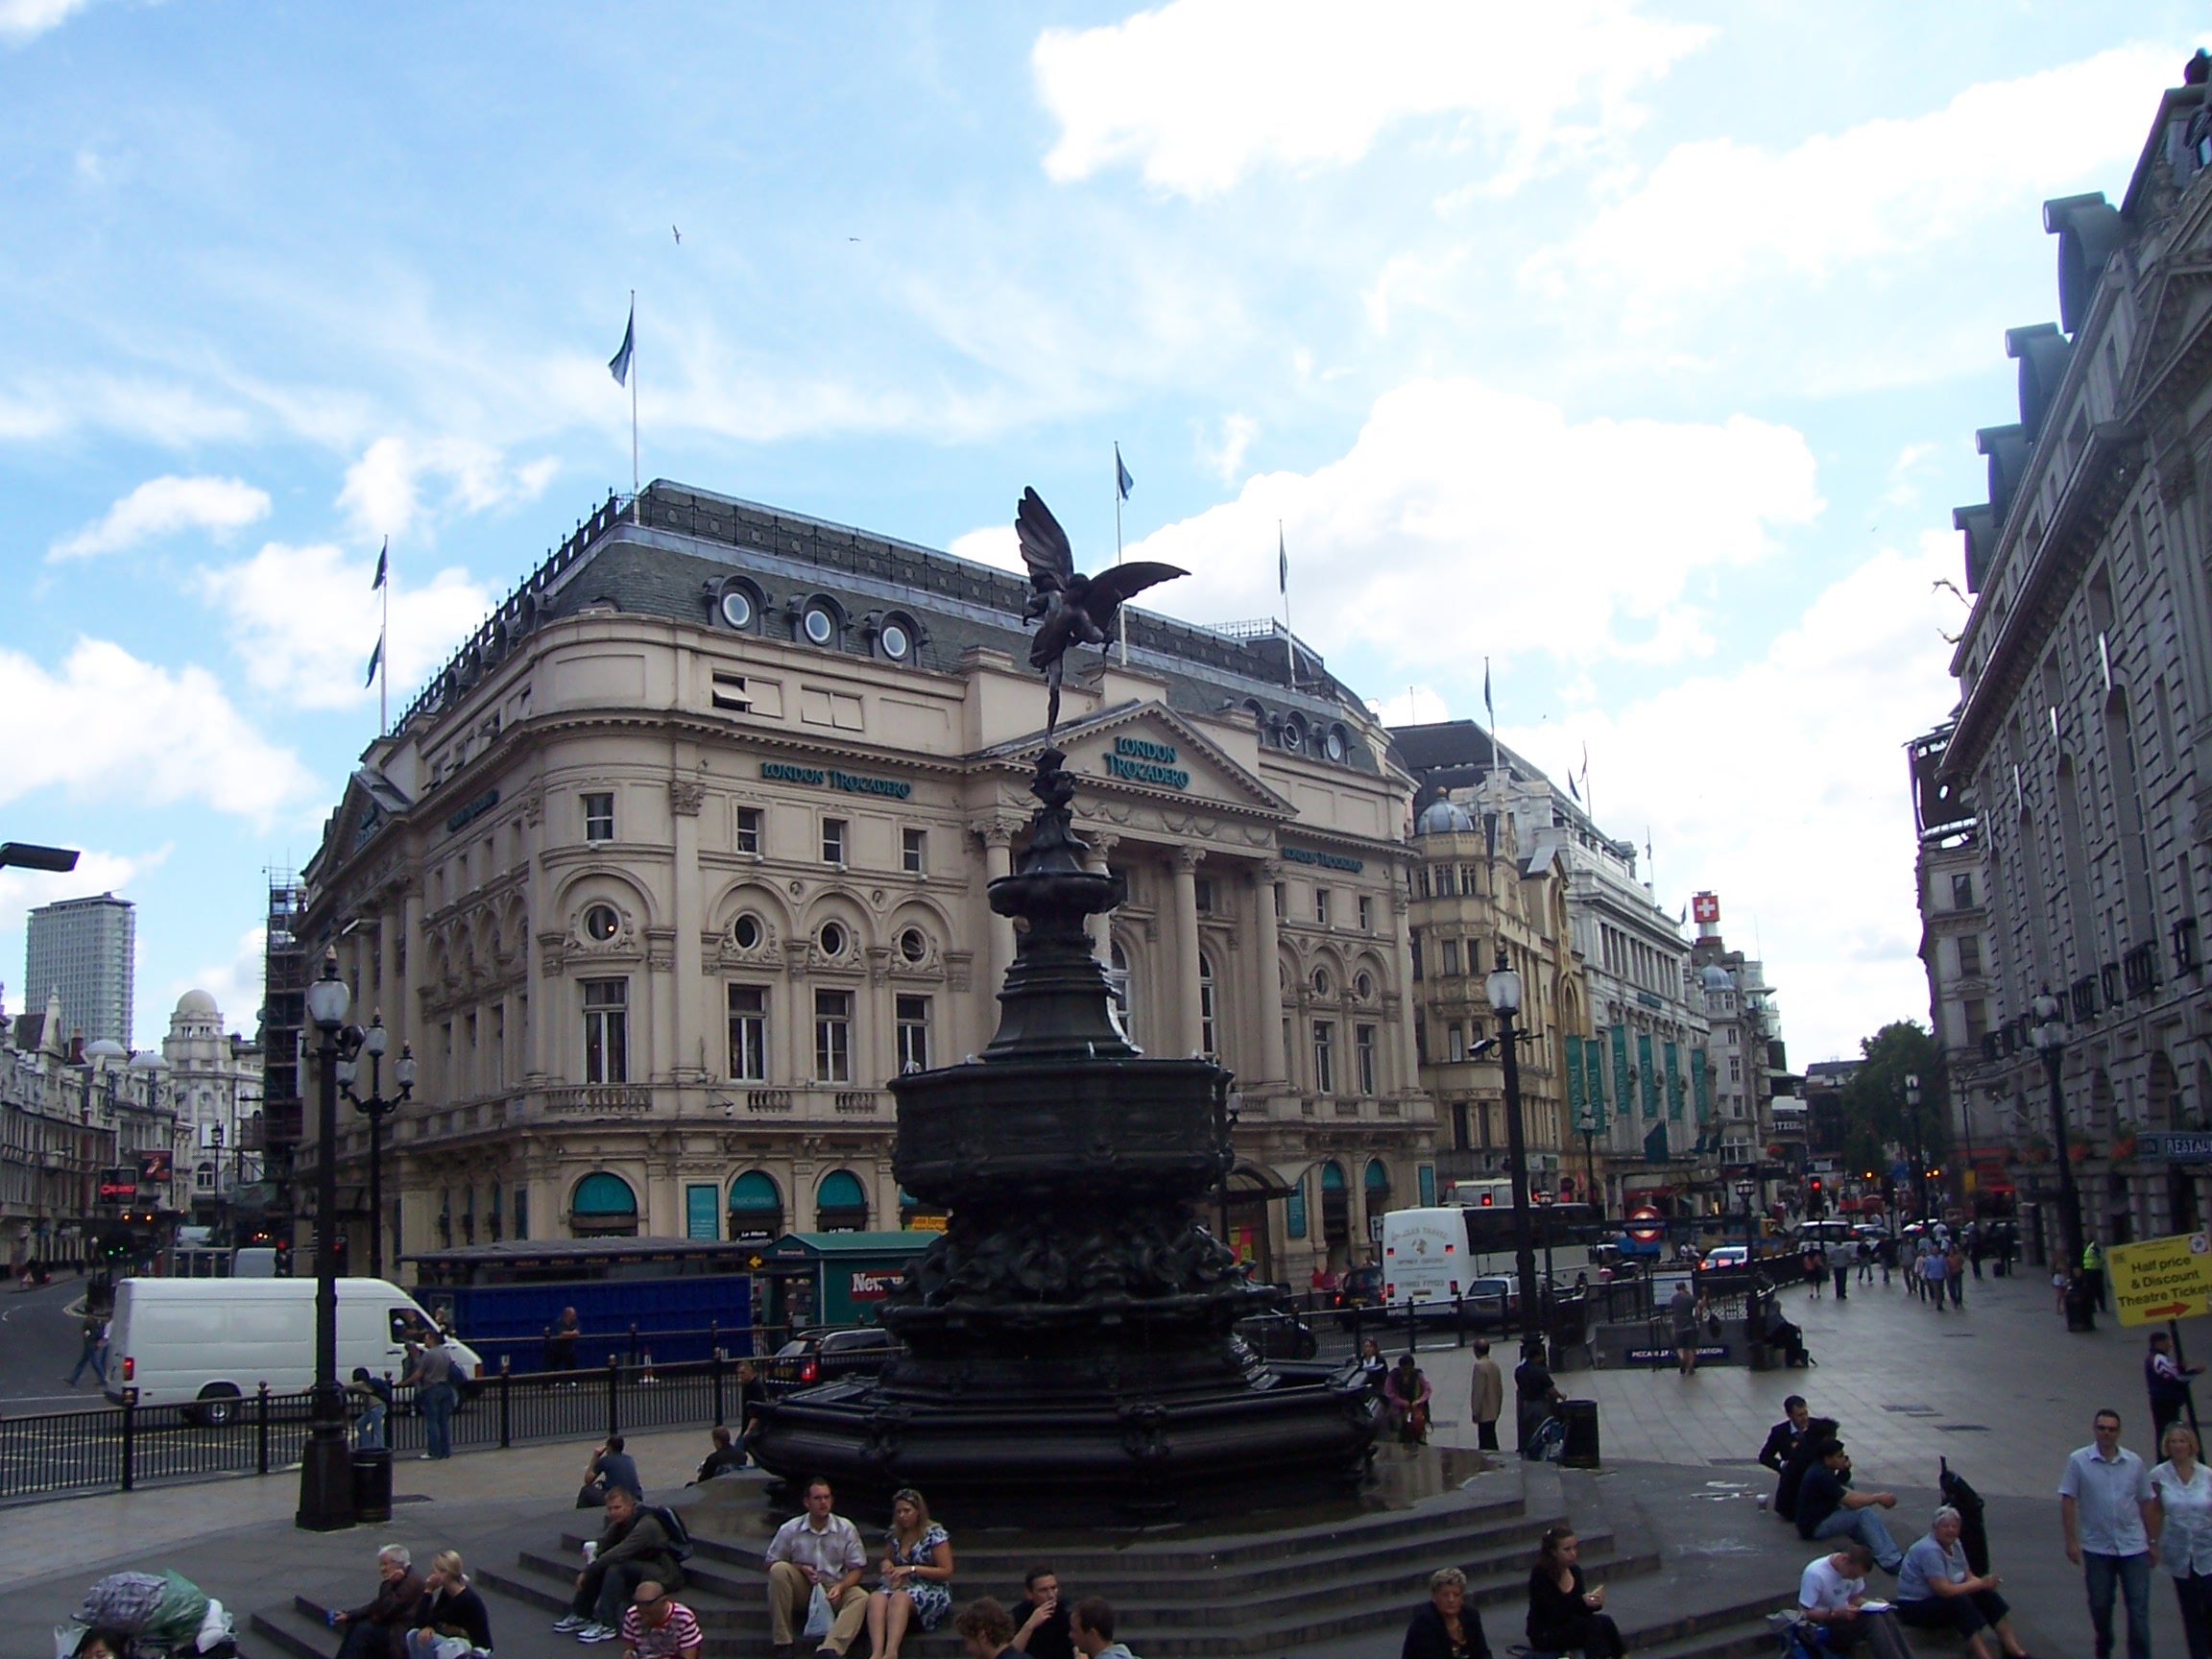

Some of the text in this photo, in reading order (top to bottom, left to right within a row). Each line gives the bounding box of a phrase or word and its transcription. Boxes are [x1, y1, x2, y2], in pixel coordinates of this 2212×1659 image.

[1115, 736, 1176, 763] LONDON
[761, 762, 912, 800] LONDON TROCADERO
[1102, 753, 1190, 789] TROCADERO
[2131, 1257, 2191, 1273] Half price
[2131, 1269, 2200, 1289] & Discount
[2118, 1291, 2168, 1308] Theatre
